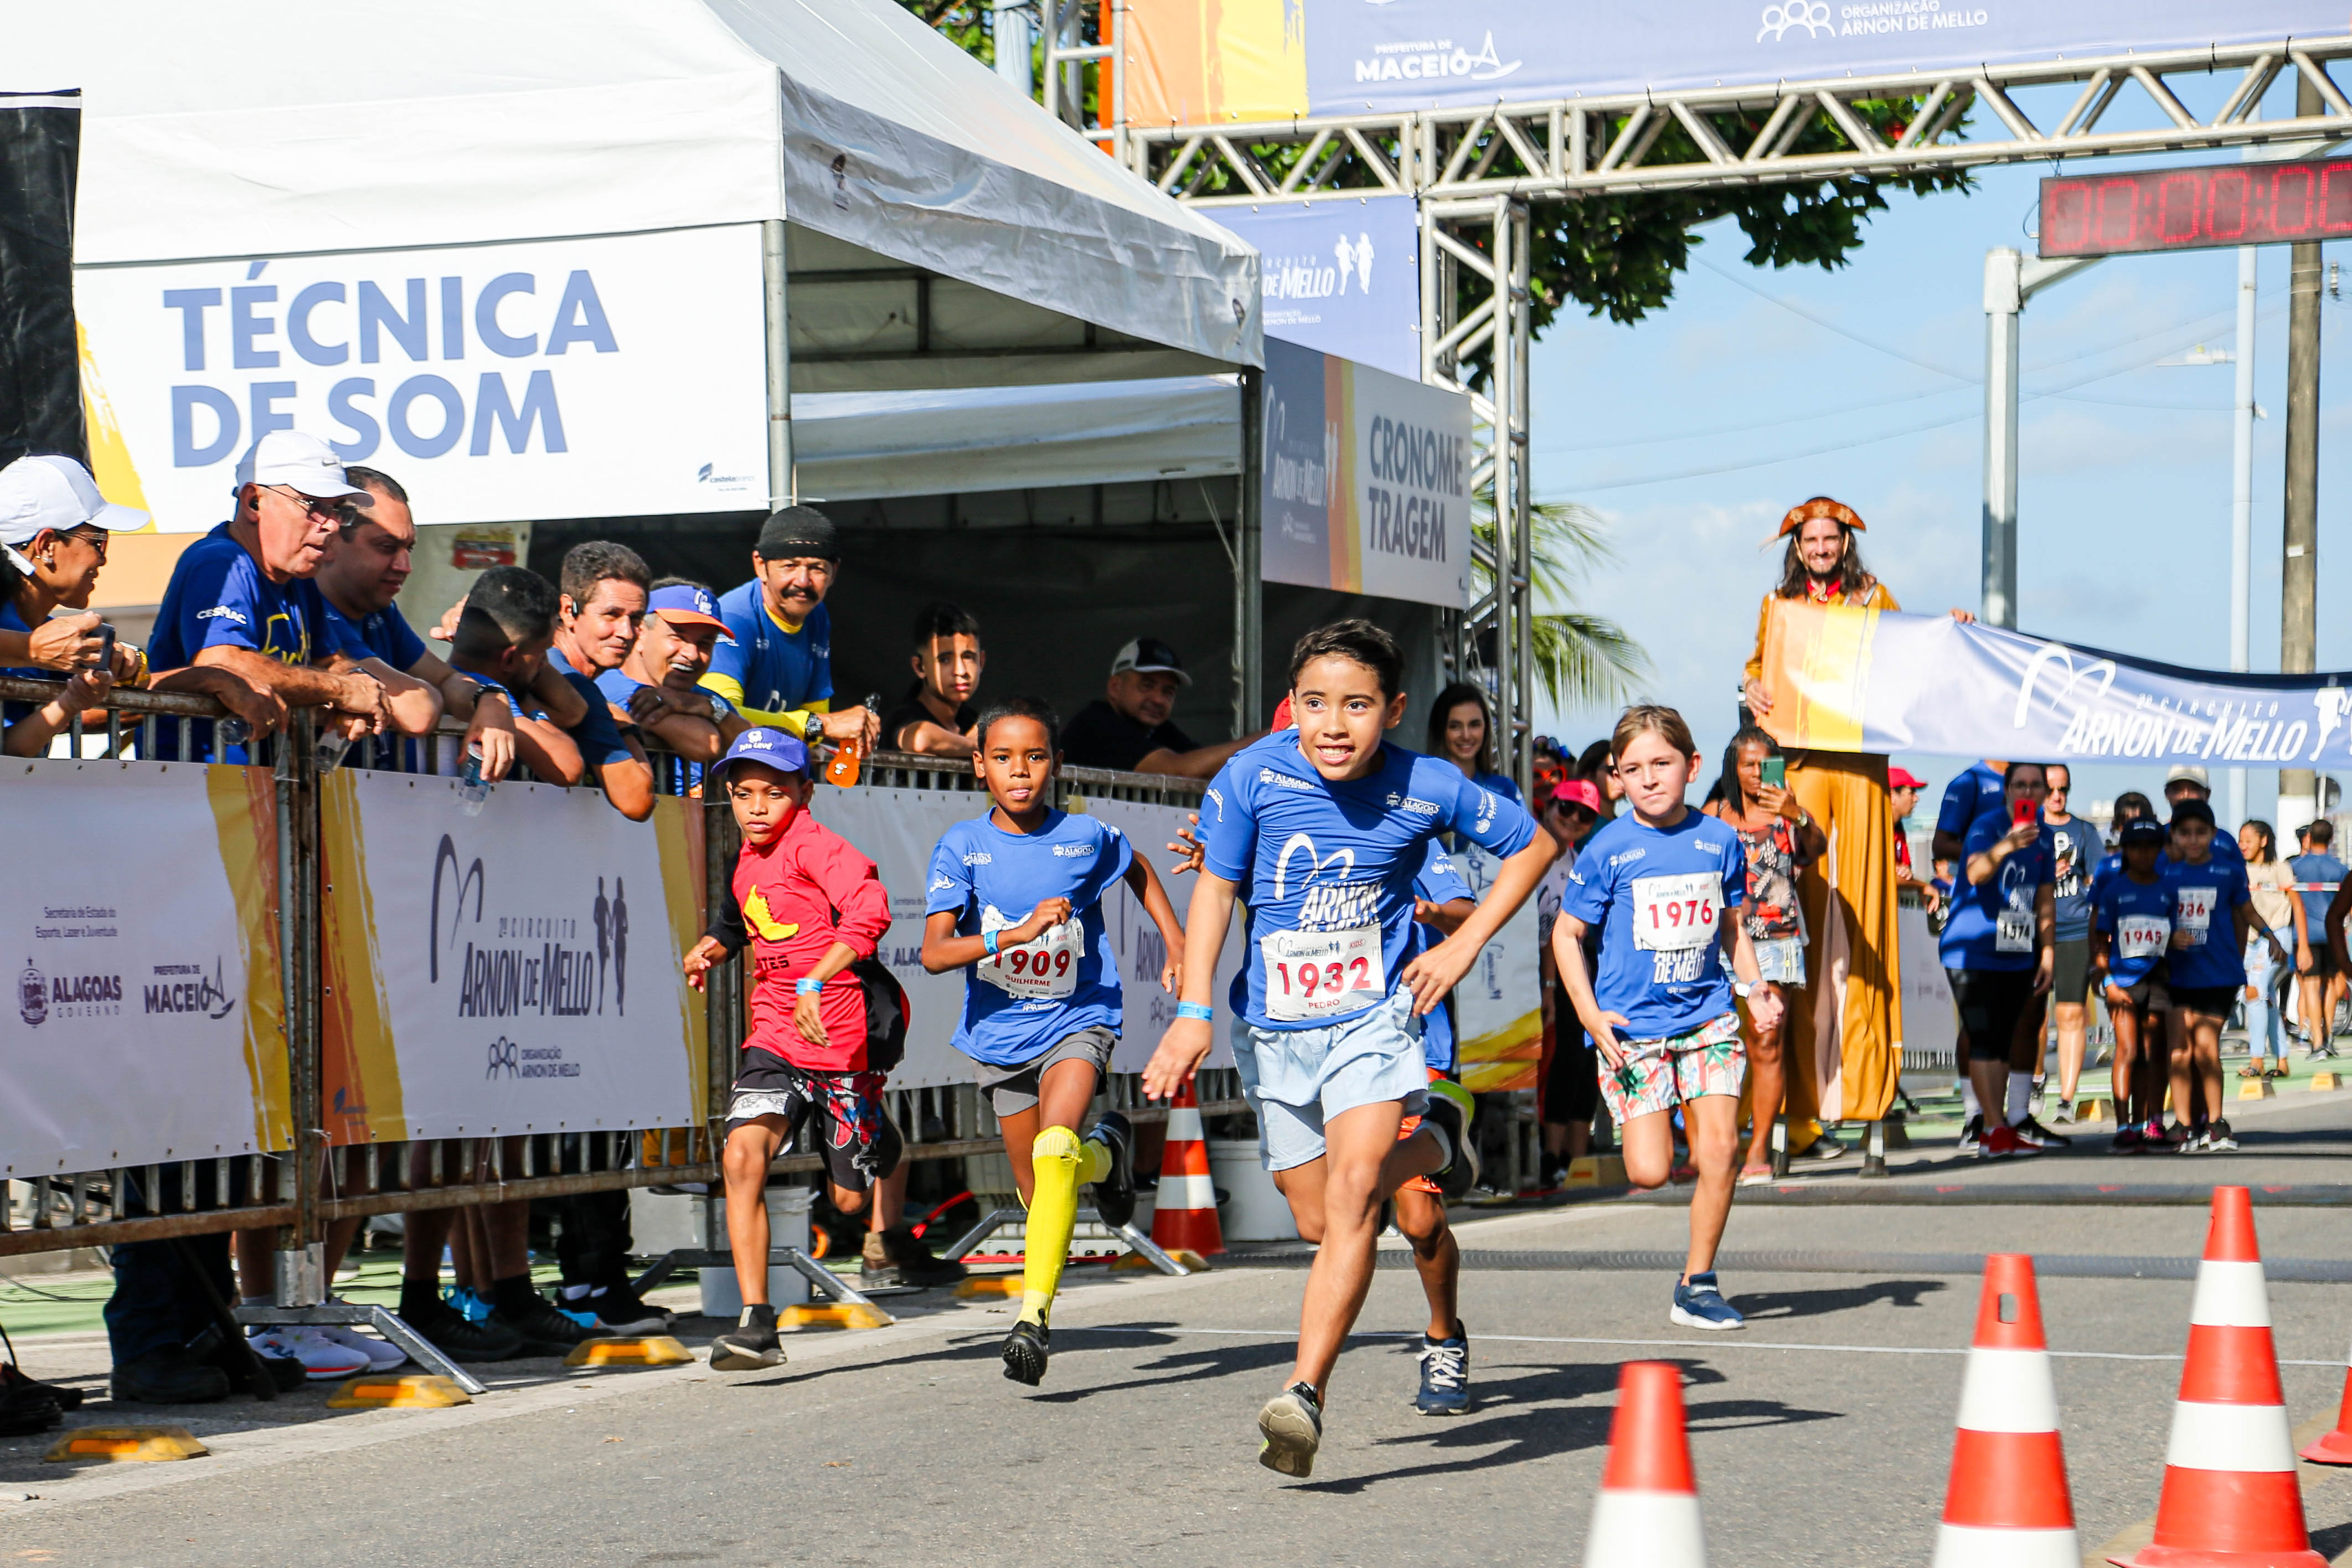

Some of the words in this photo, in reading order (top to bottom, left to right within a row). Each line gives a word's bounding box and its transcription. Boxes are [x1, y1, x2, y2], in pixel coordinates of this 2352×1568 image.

[1840, 0, 1941, 19] ORGANIZAÇÃO
[1842, 16, 1903, 37] ARNON
[1906, 13, 1930, 31] DE
[1932, 8, 1988, 29] MELLO
[1374, 40, 1437, 55] PREFEITURA
[1437, 39, 1453, 50] DE
[1355, 47, 1472, 82] MACEIÓ
[1279, 266, 1335, 300] MELLO
[163, 261, 619, 370] TÉCNICA
[1298, 314, 1321, 324] MELLO
[172, 380, 297, 468] DE
[328, 369, 568, 461] SOM
[1370, 414, 1463, 497] CRONOME
[1369, 486, 1446, 563] TRAGEM
[2160, 695, 2279, 718] CIRCUITO
[2057, 704, 2175, 759] ARNON
[2172, 724, 2207, 755] DE
[2200, 715, 2308, 762] MELLO
[512, 917, 576, 939] CIRCUITO
[1648, 899, 1713, 929] 1976
[1349, 940, 1364, 949] KIDS
[153, 965, 190, 976] PREFEITURA
[192, 964, 200, 974] DE
[459, 942, 522, 1018] ARNON
[523, 958, 540, 1007] DE
[540, 942, 594, 1016] MELLO
[1005, 974, 1050, 987] GUILHERME
[1277, 956, 1371, 998] 1932
[1653, 962, 1674, 984] DE
[52, 974, 122, 1003] ALAGOAS
[143, 975, 210, 1014] MACEIÓ
[57, 1005, 120, 1018] GOVERNO
[1308, 999, 1340, 1009] PEDRO
